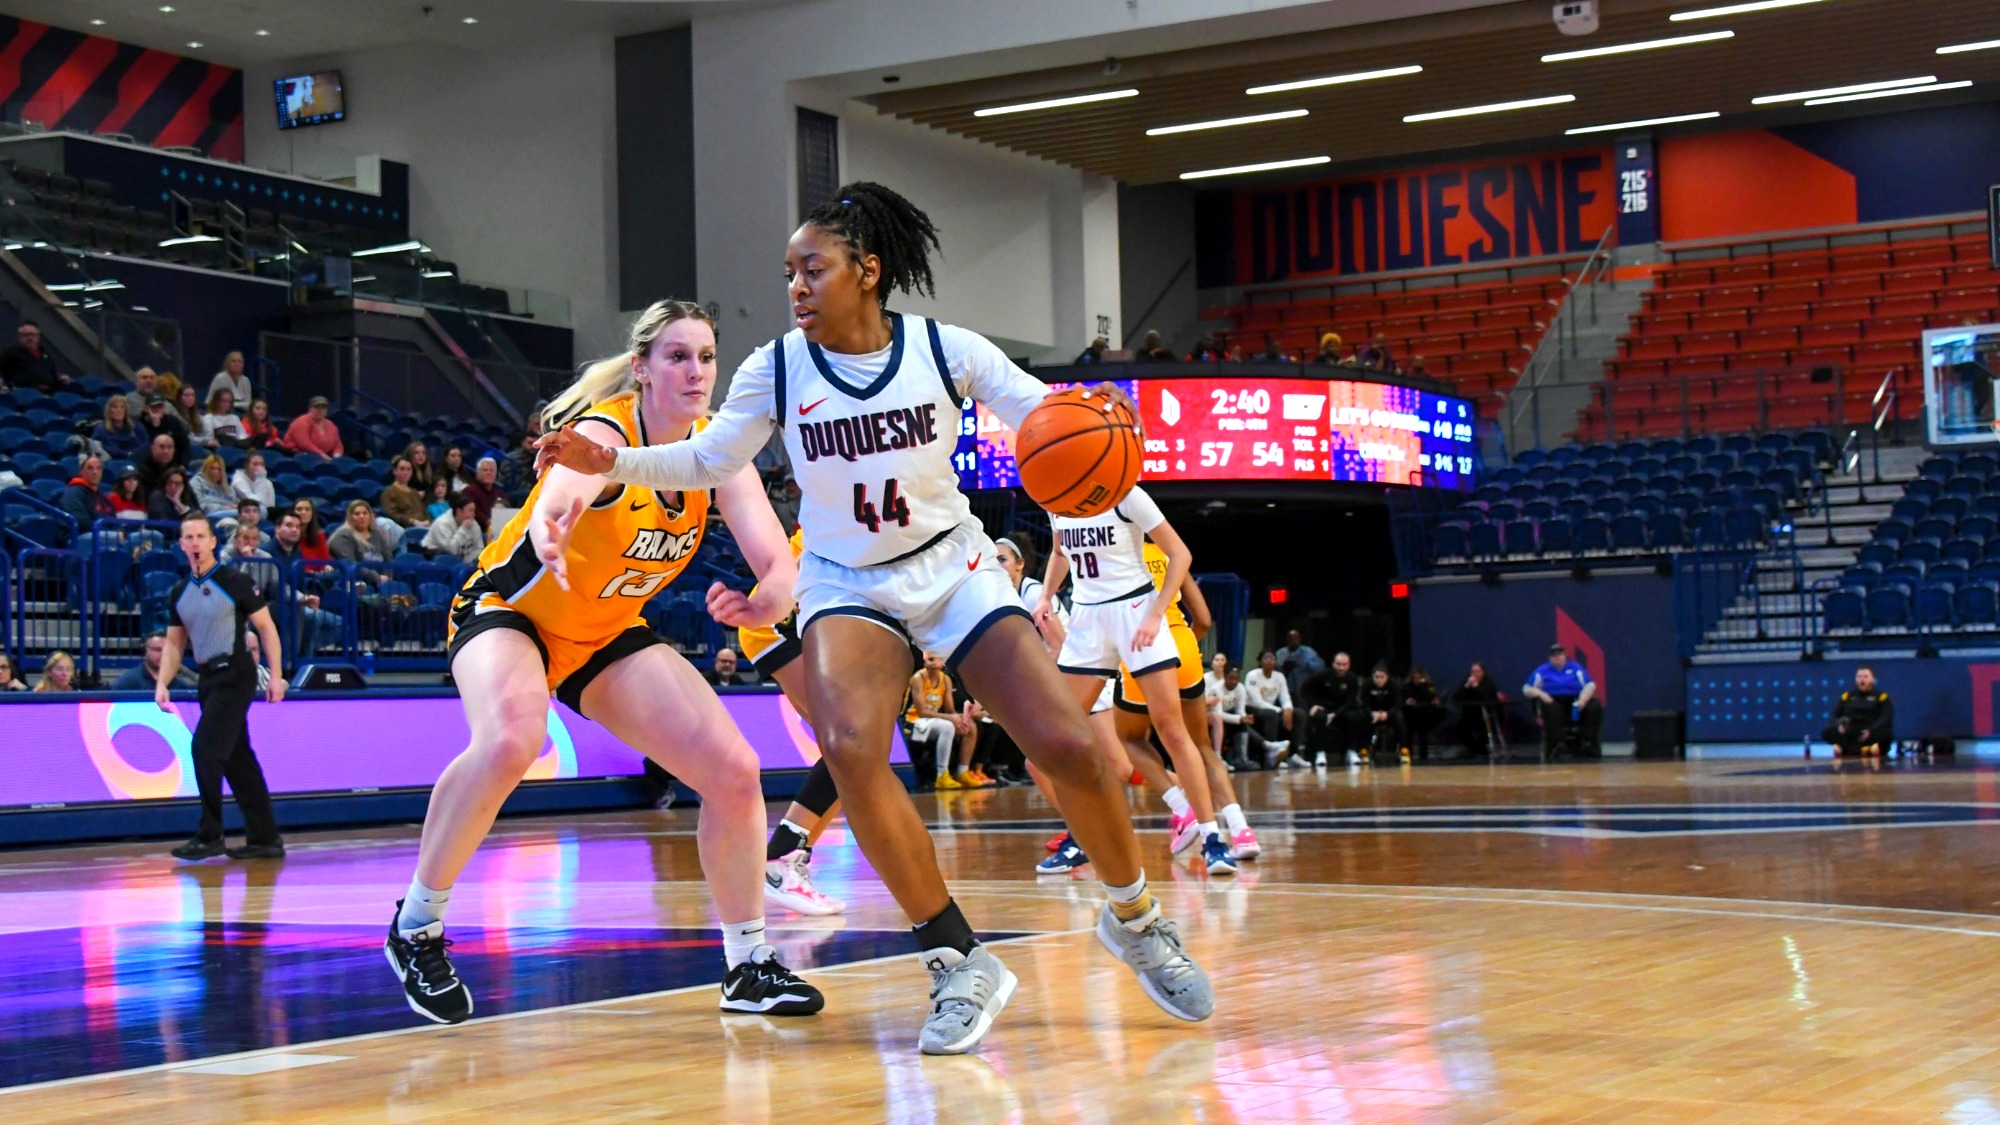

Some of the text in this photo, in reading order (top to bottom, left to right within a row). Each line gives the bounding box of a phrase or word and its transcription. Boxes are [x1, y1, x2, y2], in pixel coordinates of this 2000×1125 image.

[1621, 169, 1647, 192] 215
[1622, 191, 1648, 213] 216
[1251, 155, 1602, 284] DUQUESNE
[1211, 389, 1270, 414] 2:40
[798, 403, 937, 462] DUQUESNE
[1176, 439, 1185, 451] 3
[1200, 441, 1234, 466] 57
[1252, 441, 1284, 466] 54
[1320, 439, 1329, 452] 2
[955, 451, 976, 471] 11
[1143, 460, 1186, 472] FLS 4
[1322, 459, 1329, 471] 1
[854, 478, 911, 533] 44
[621, 525, 699, 562] RAMS
[1058, 525, 1116, 551] UQUESNE
